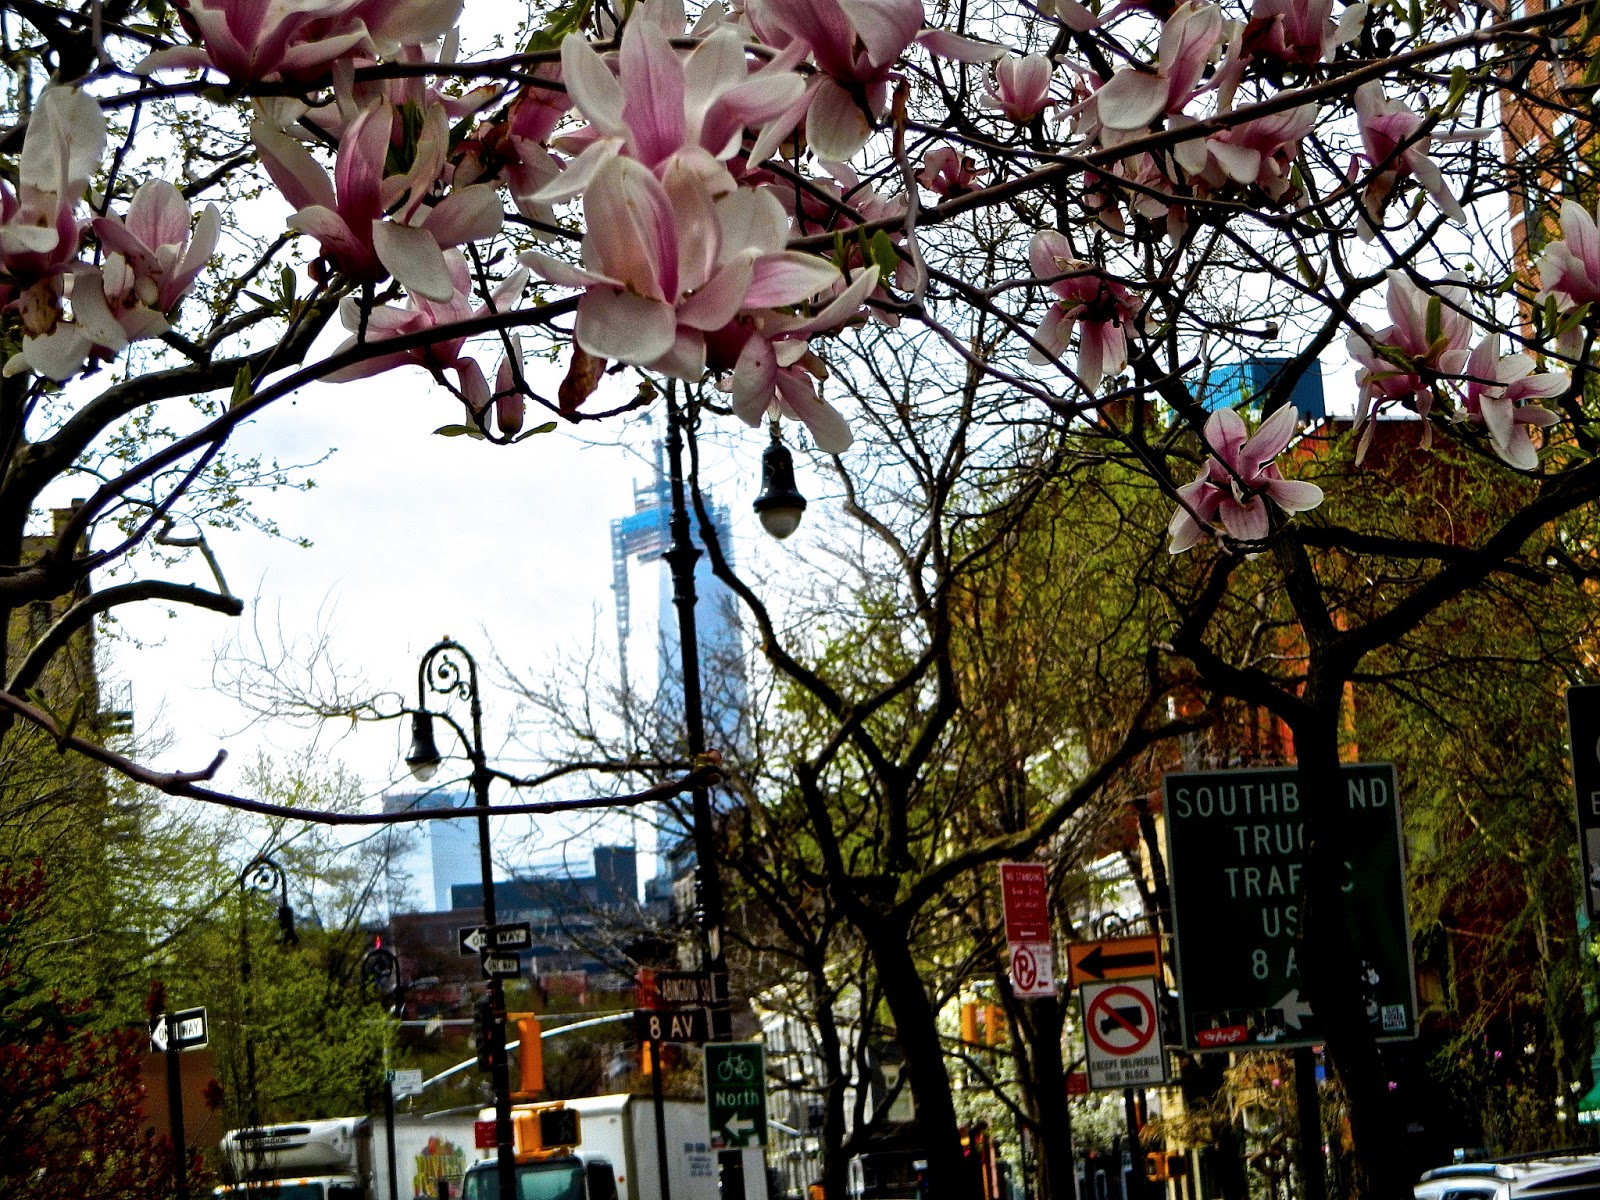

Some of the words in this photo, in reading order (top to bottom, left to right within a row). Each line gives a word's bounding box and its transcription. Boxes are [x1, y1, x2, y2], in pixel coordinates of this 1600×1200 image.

[1176, 777, 1388, 818] SOUTHBND
[1252, 948, 1268, 980] 8
[180, 1020, 199, 1037] WAY
[649, 1015, 662, 1040] 8
[671, 1015, 693, 1038] AV
[715, 1089, 760, 1107] North
